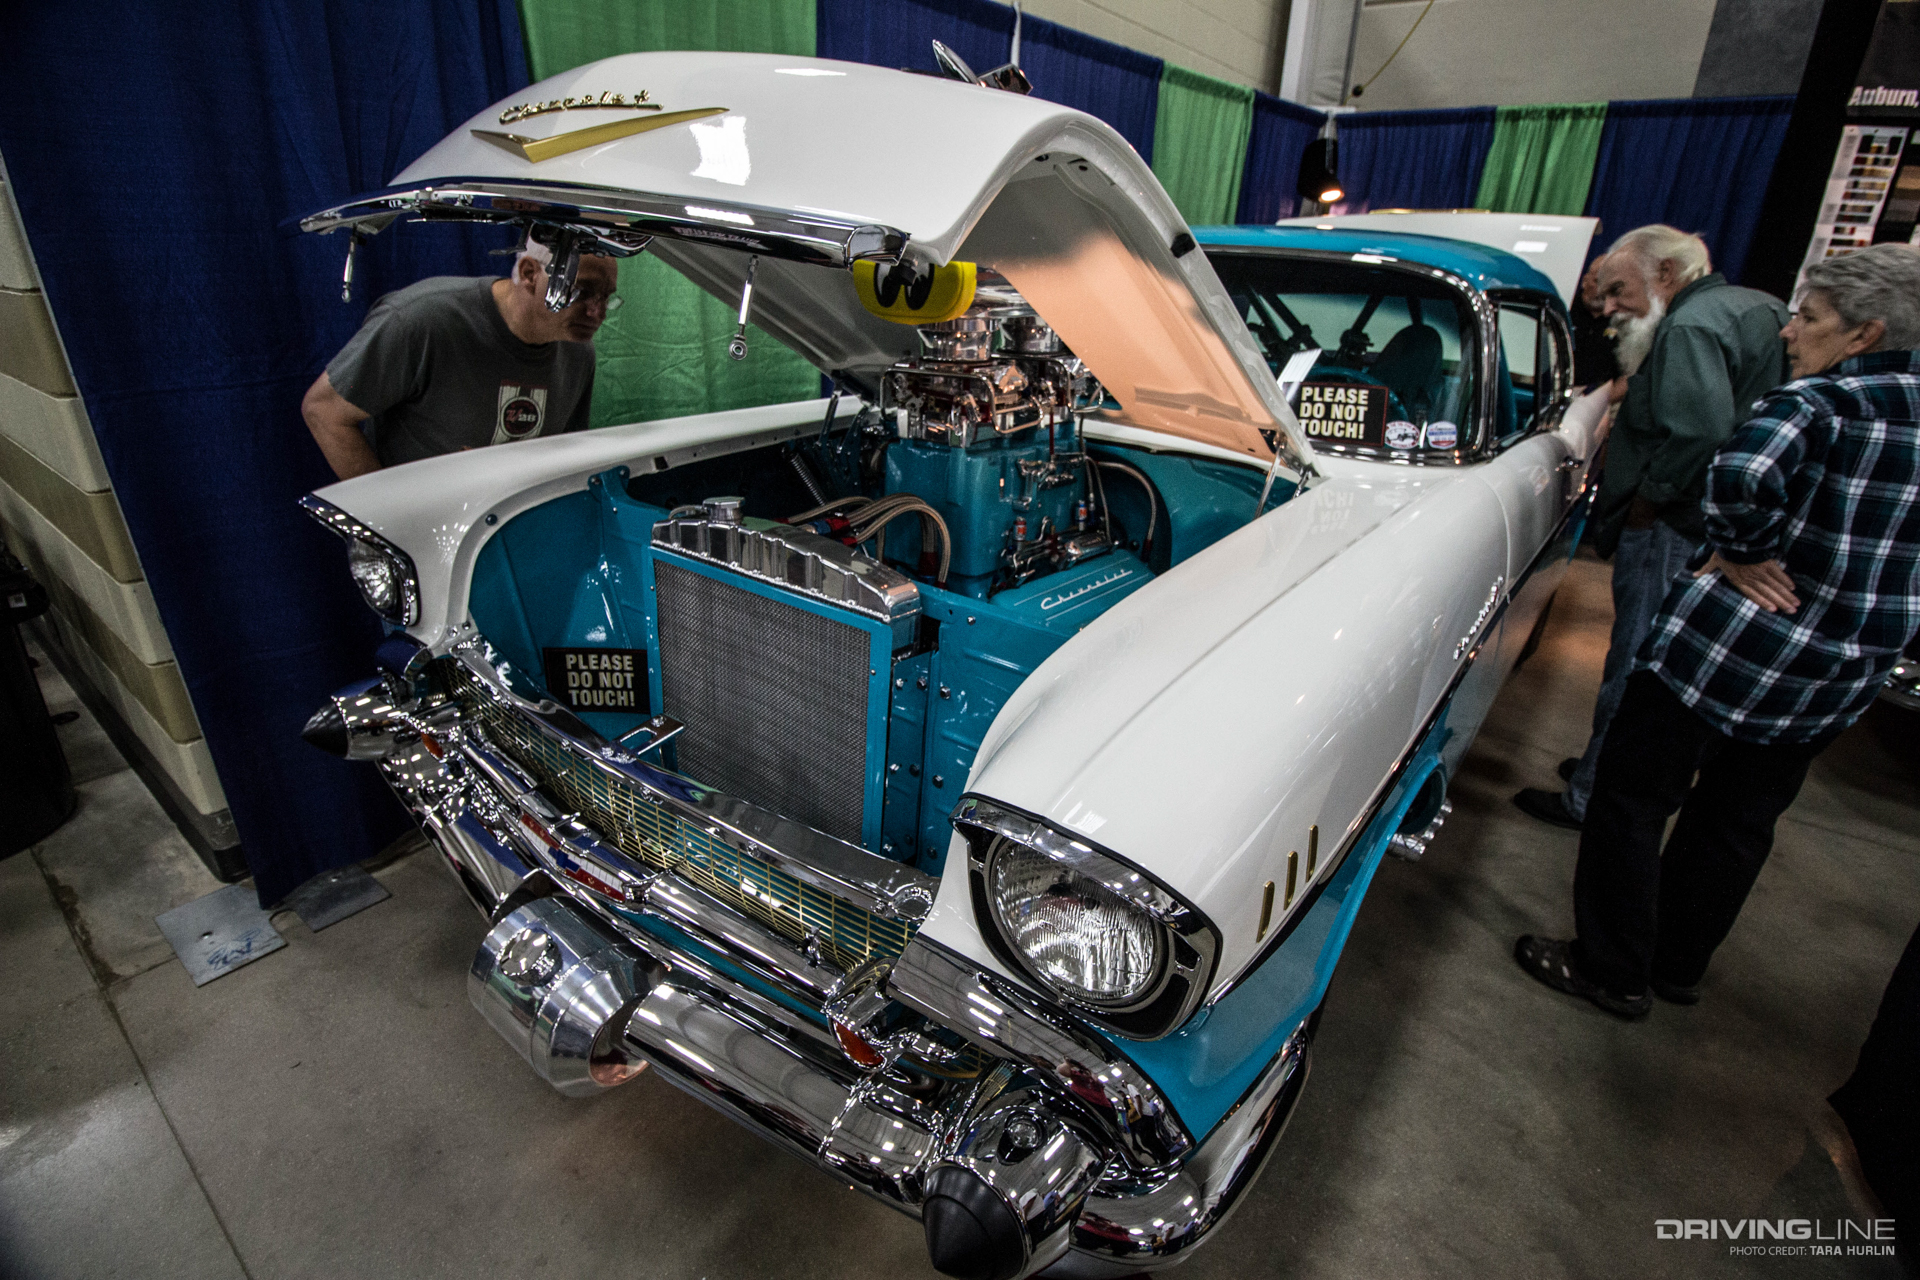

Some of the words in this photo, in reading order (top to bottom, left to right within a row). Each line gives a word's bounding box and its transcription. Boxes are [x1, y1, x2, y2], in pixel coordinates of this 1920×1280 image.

[1847, 86, 1919, 108] Auburn,
[1301, 386, 1369, 406] PLEASE
[1299, 402, 1326, 419] DO
[1330, 404, 1368, 422] NOT
[1298, 419, 1365, 440] TOUCH!
[565, 653, 634, 671] PLEASE
[567, 671, 593, 688] DO
[599, 671, 634, 689] NOT
[568, 689, 635, 707] TOUCH!
